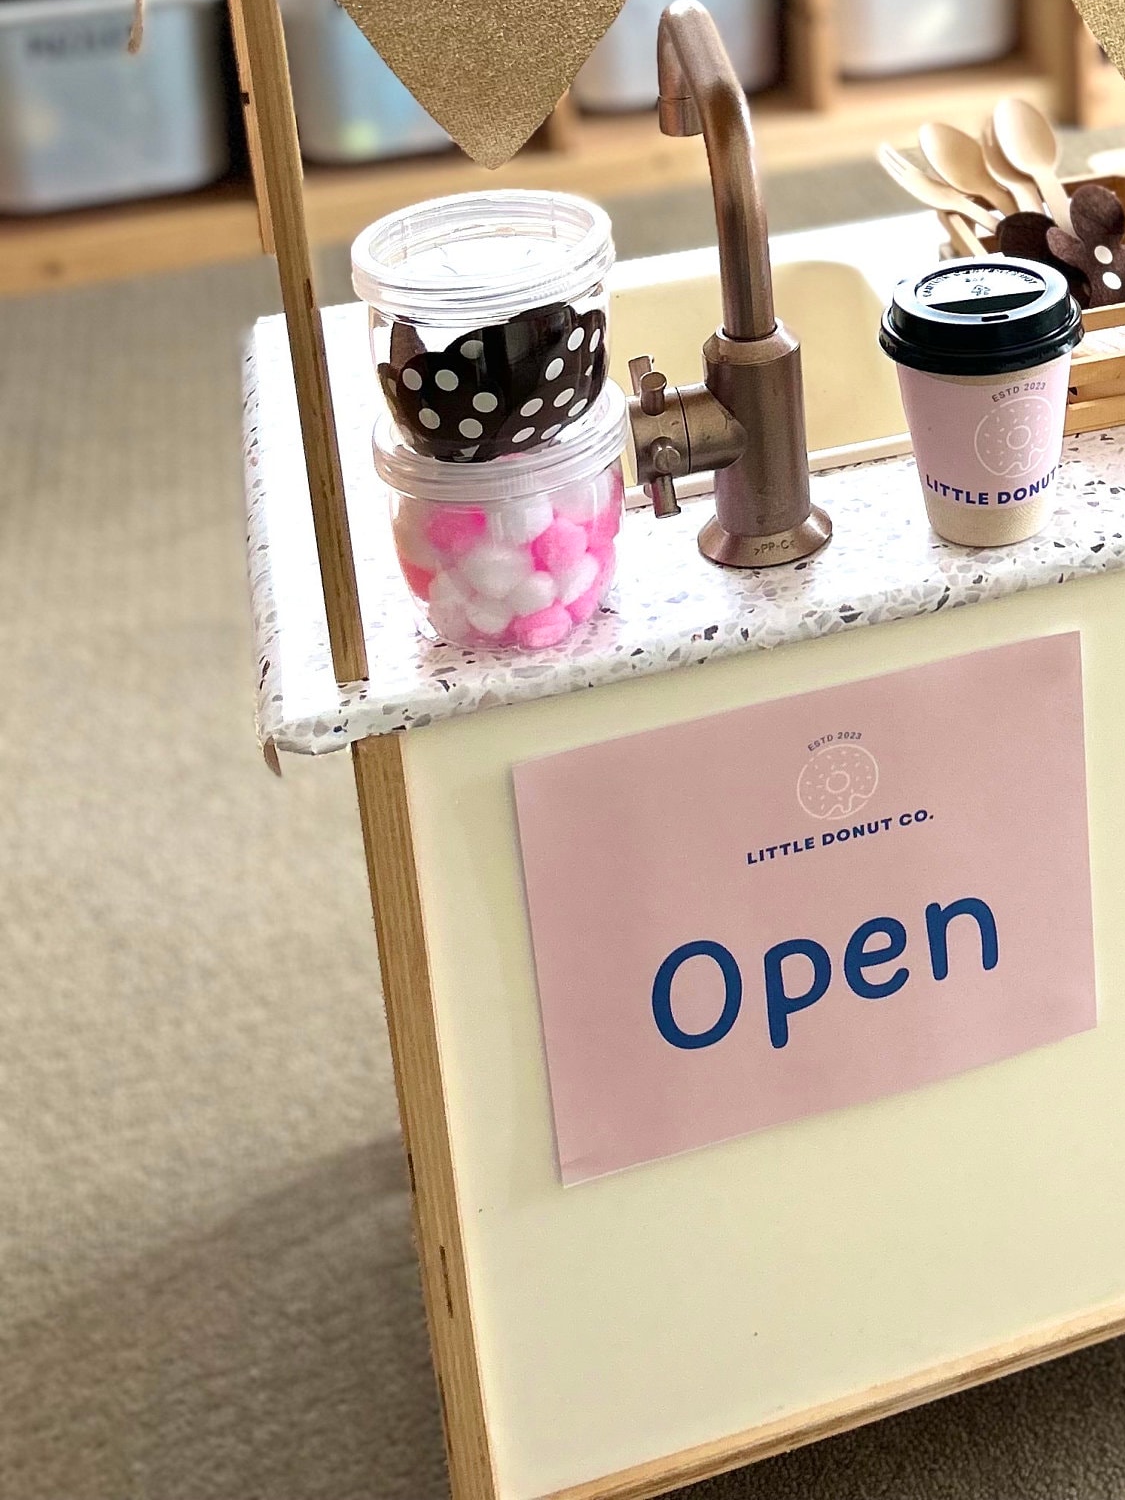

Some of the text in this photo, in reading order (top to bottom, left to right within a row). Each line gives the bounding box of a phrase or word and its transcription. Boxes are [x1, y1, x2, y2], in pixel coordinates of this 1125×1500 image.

[991, 381, 1046, 403] ESTD 2023
[926, 466, 1057, 506] LITTLE DONUT
[807, 731, 862, 751] ESTD 2023
[747, 809, 934, 865] LITTLE DONUT CO.
[652, 897, 999, 1049] Open
